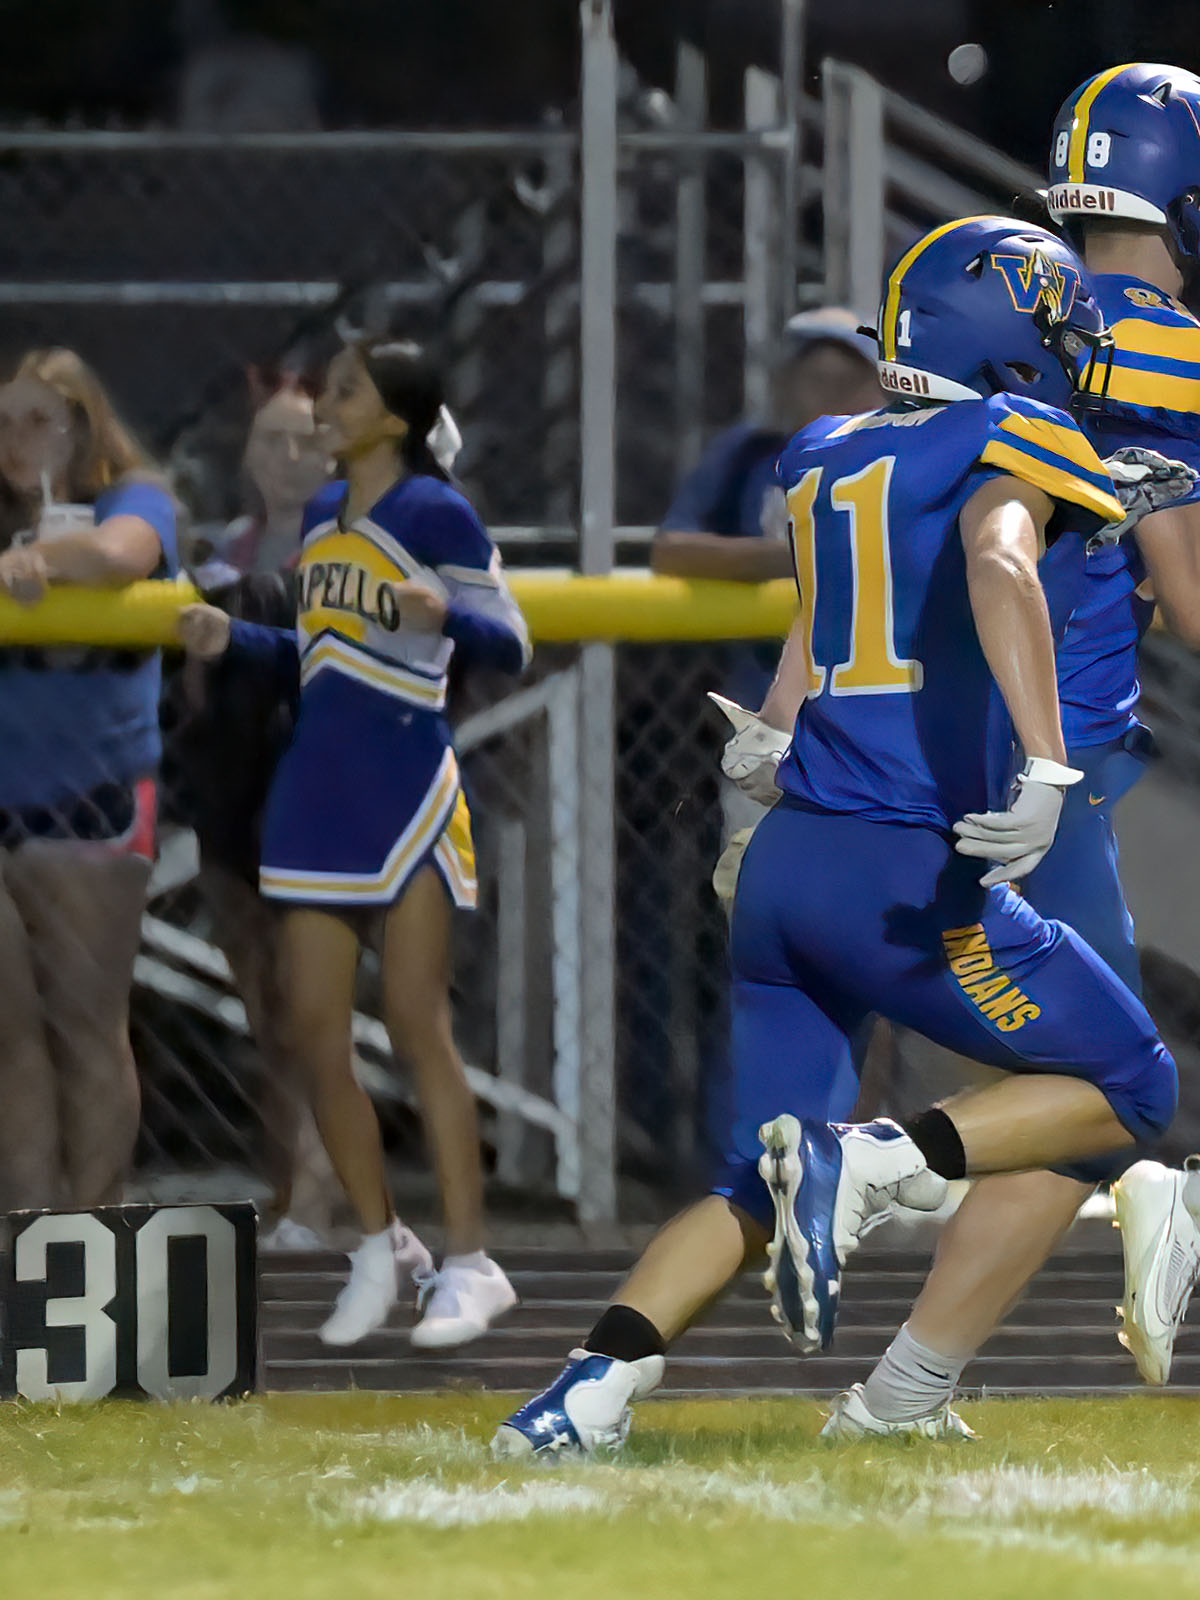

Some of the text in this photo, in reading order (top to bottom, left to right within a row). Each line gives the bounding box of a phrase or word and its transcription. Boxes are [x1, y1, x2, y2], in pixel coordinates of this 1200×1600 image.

[1055, 131, 1112, 168] 88
[786, 455, 924, 699] 11
[941, 922, 1042, 1032] INDIANS
[15, 1206, 238, 1405] 30
